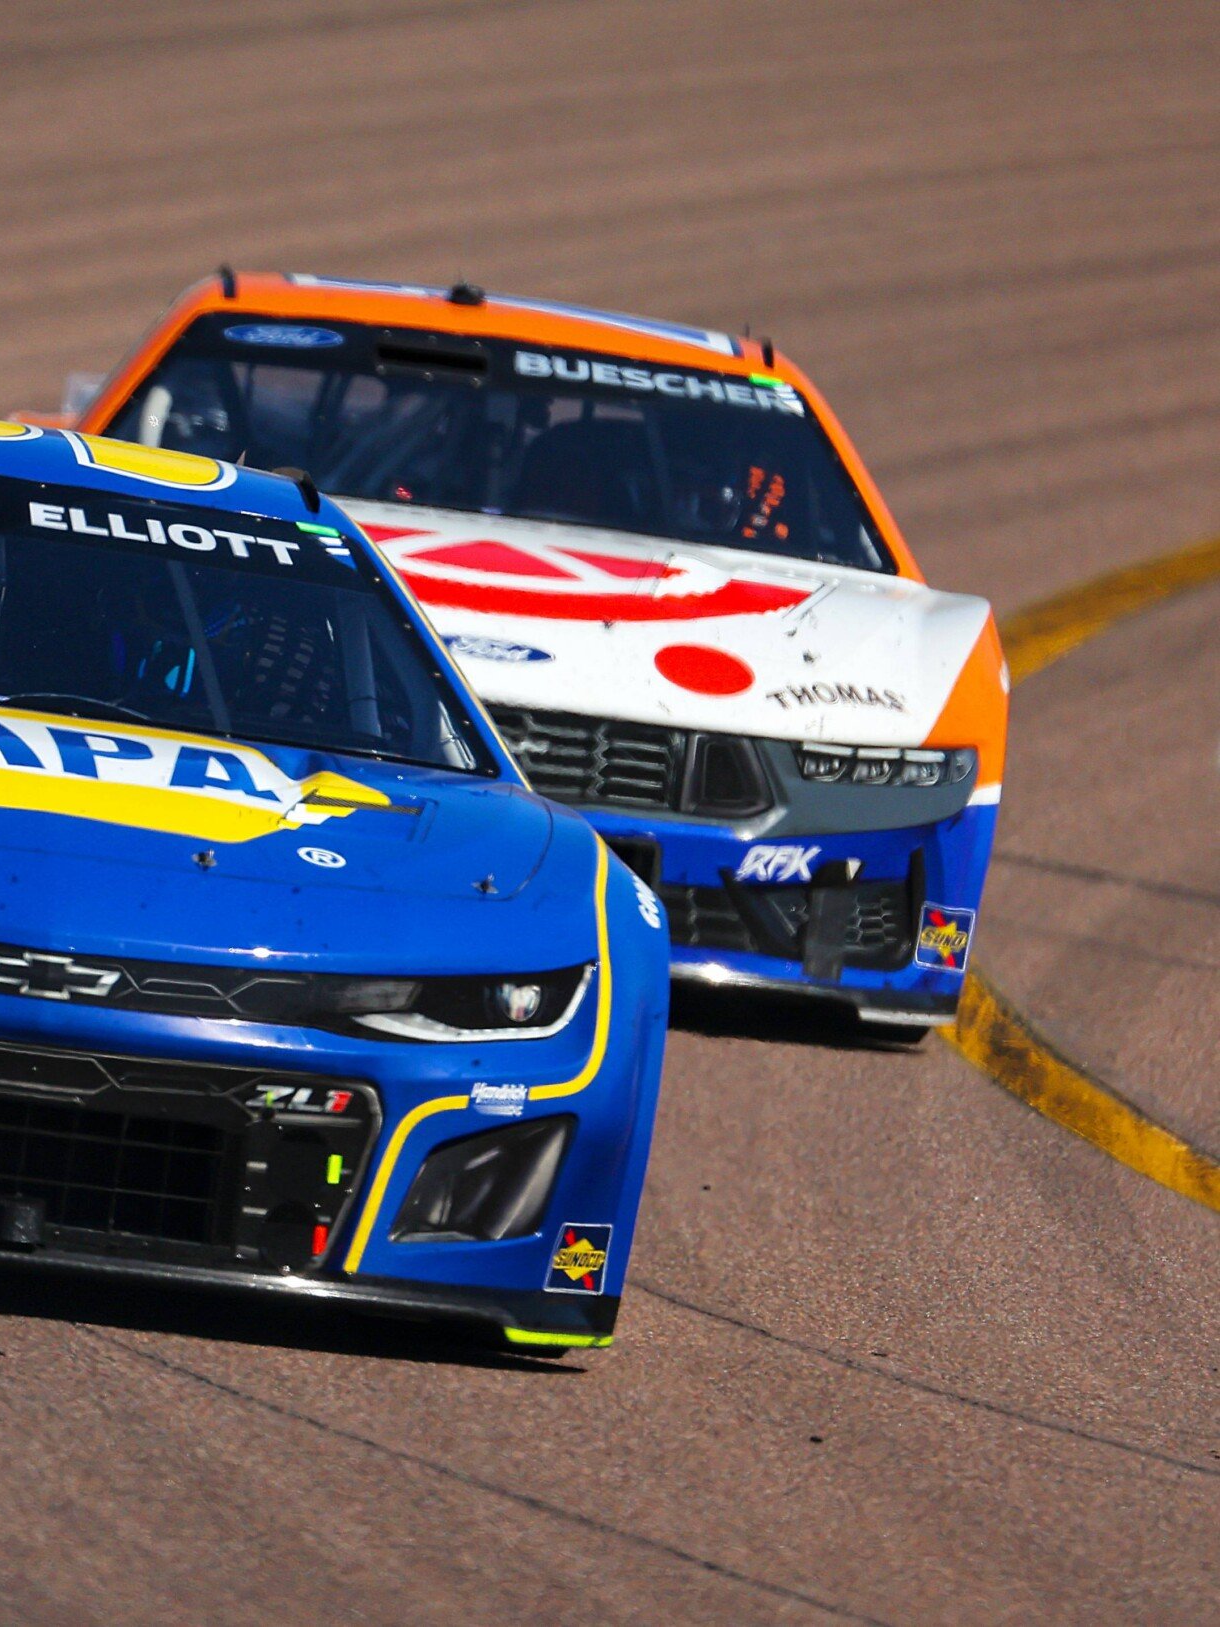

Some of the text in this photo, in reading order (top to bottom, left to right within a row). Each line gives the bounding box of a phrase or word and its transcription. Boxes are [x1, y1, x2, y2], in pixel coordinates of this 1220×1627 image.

[514, 350, 792, 413] BUESCHER
[28, 501, 301, 567] ELLIOTT
[765, 681, 908, 714] THOMAS
[245, 1084, 354, 1114] ZL1
[554, 1250, 604, 1269] SUNOCO
